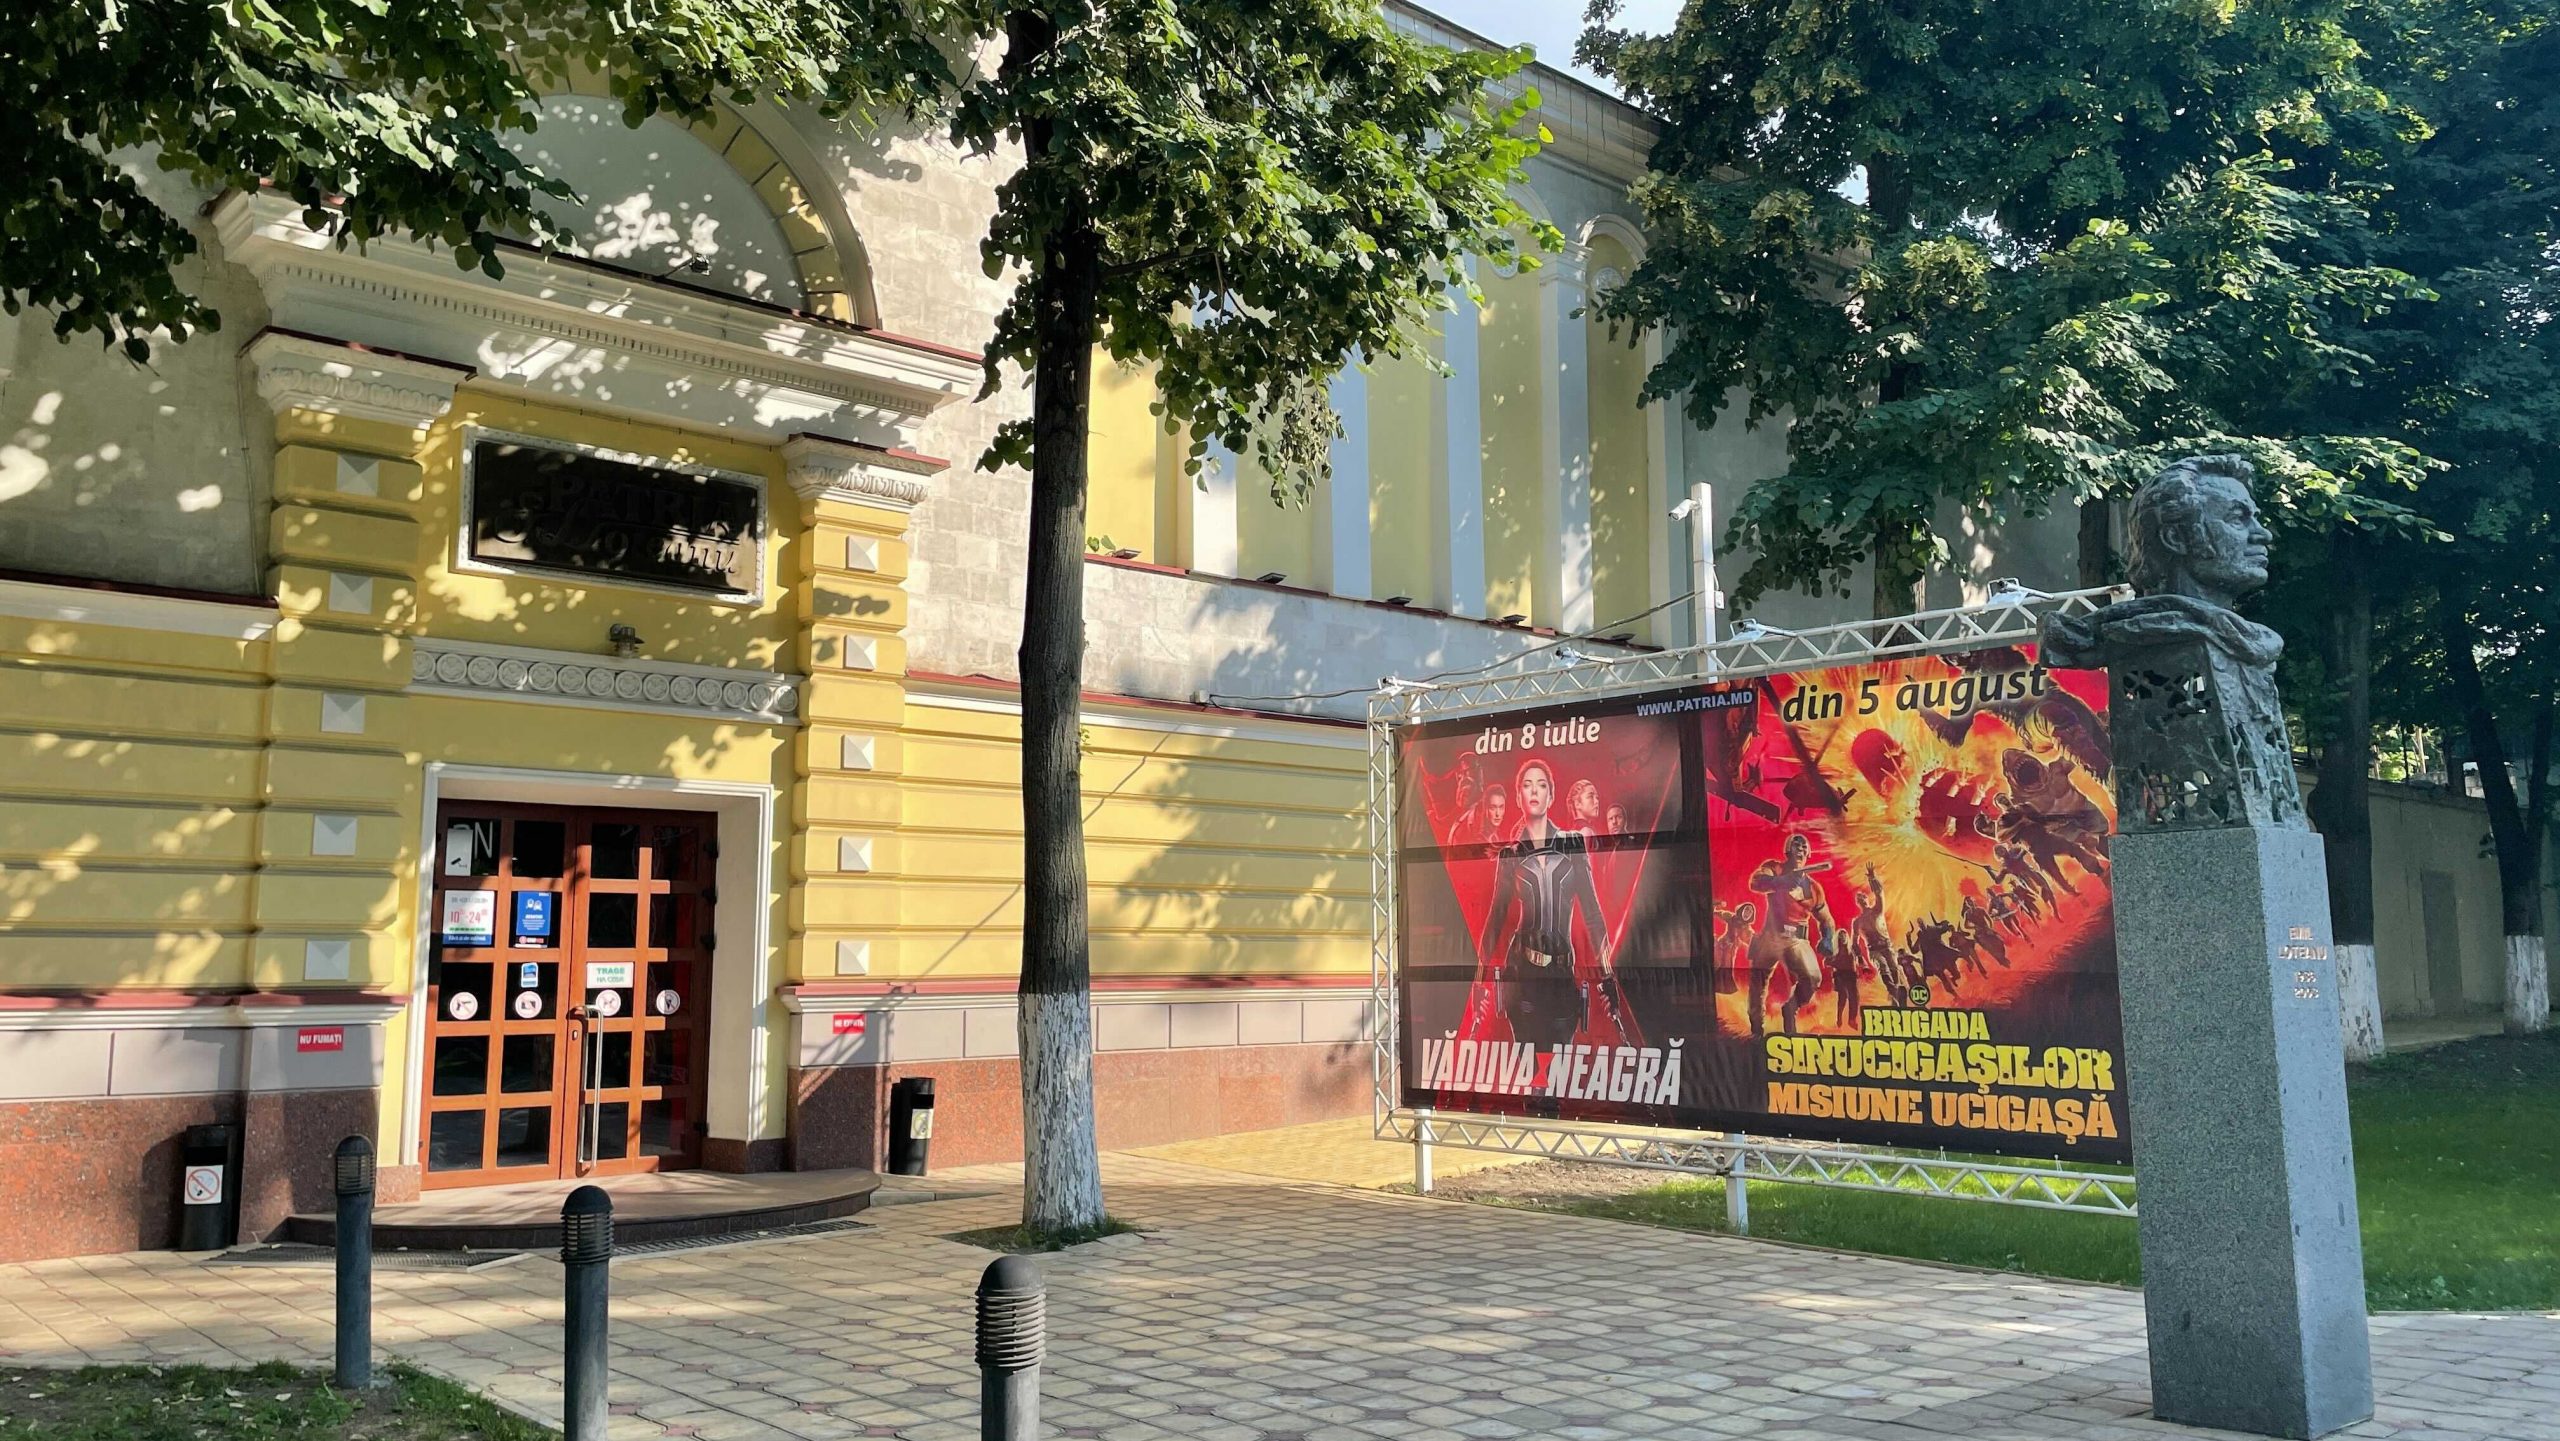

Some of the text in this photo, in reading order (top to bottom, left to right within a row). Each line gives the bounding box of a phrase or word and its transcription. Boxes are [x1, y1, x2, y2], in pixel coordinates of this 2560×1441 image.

[1637, 690, 1753, 717] WWW.PATRIA.MD
[1783, 664, 2048, 723] din 5 august
[1475, 716, 1601, 755] din 8 iulie
[300, 1035, 312, 1044] NU
[1863, 1009, 1990, 1041] BRIGADA
[1421, 1029, 1685, 1106] VĂDUVA NEAGRĂ
[1768, 1081, 1923, 1124] MISIUNE
